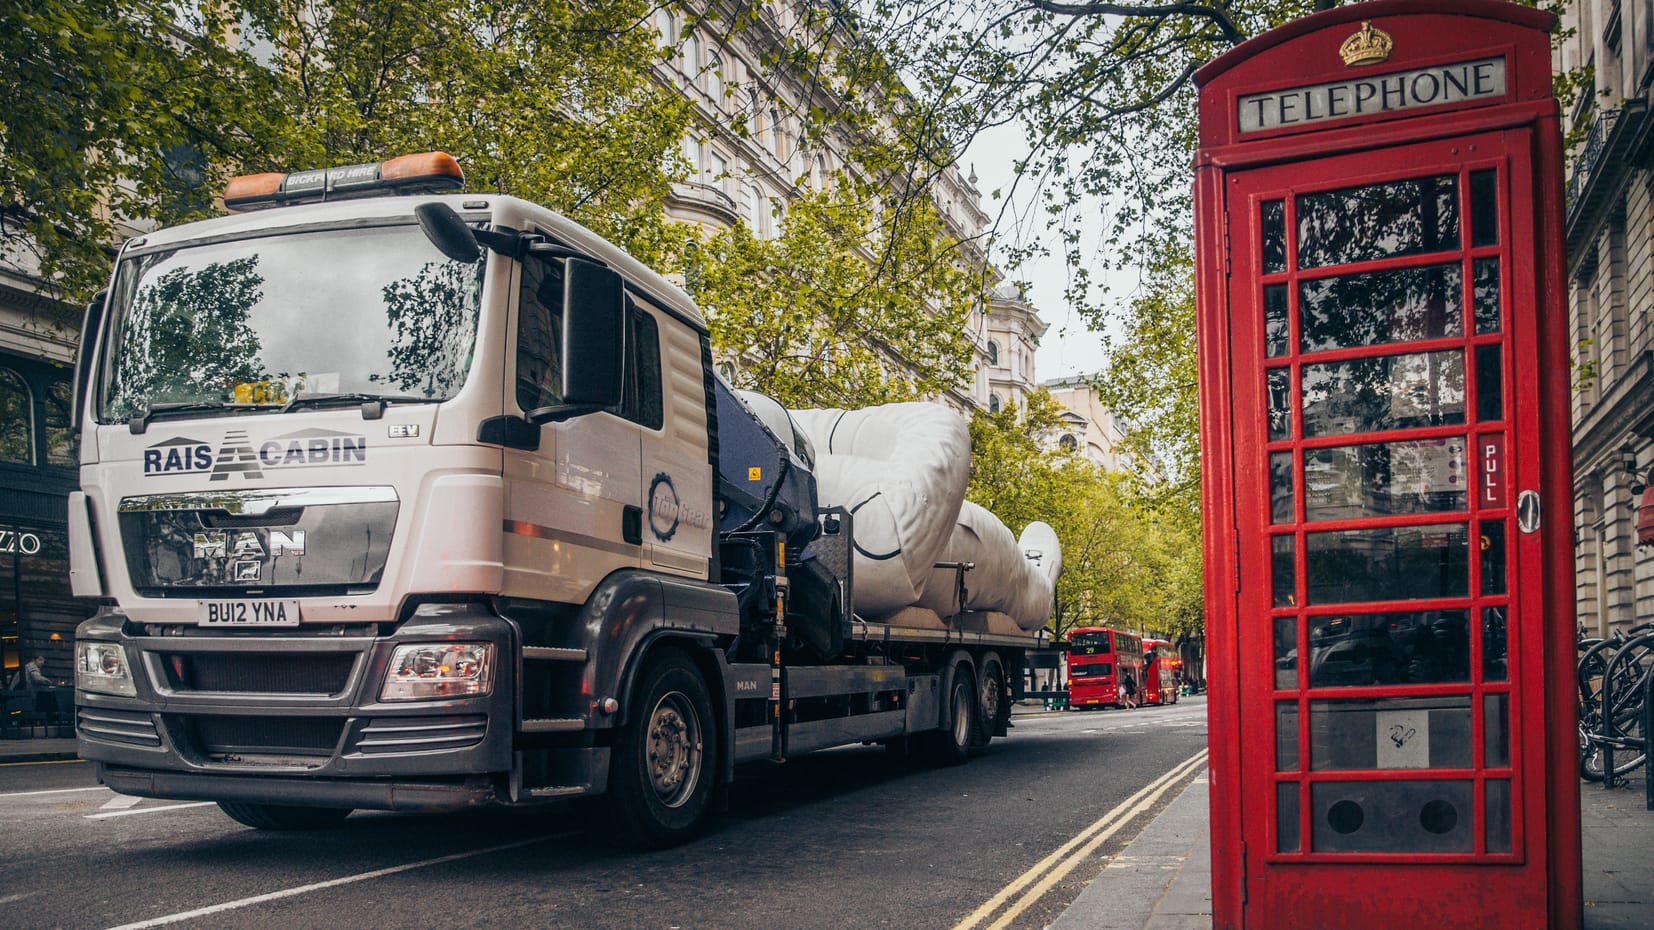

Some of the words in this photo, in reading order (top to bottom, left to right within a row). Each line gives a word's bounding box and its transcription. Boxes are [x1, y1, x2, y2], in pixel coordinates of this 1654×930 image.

[1248, 63, 1495, 127] TELEPHONE
[347, 166, 377, 178] HIRE
[389, 425, 419, 437] EEV
[1486, 445, 1497, 501] PULL
[194, 531, 305, 558] MAN
[209, 603, 247, 623] BU12
[252, 602, 287, 622] YNA
[737, 681, 757, 690] MAN
